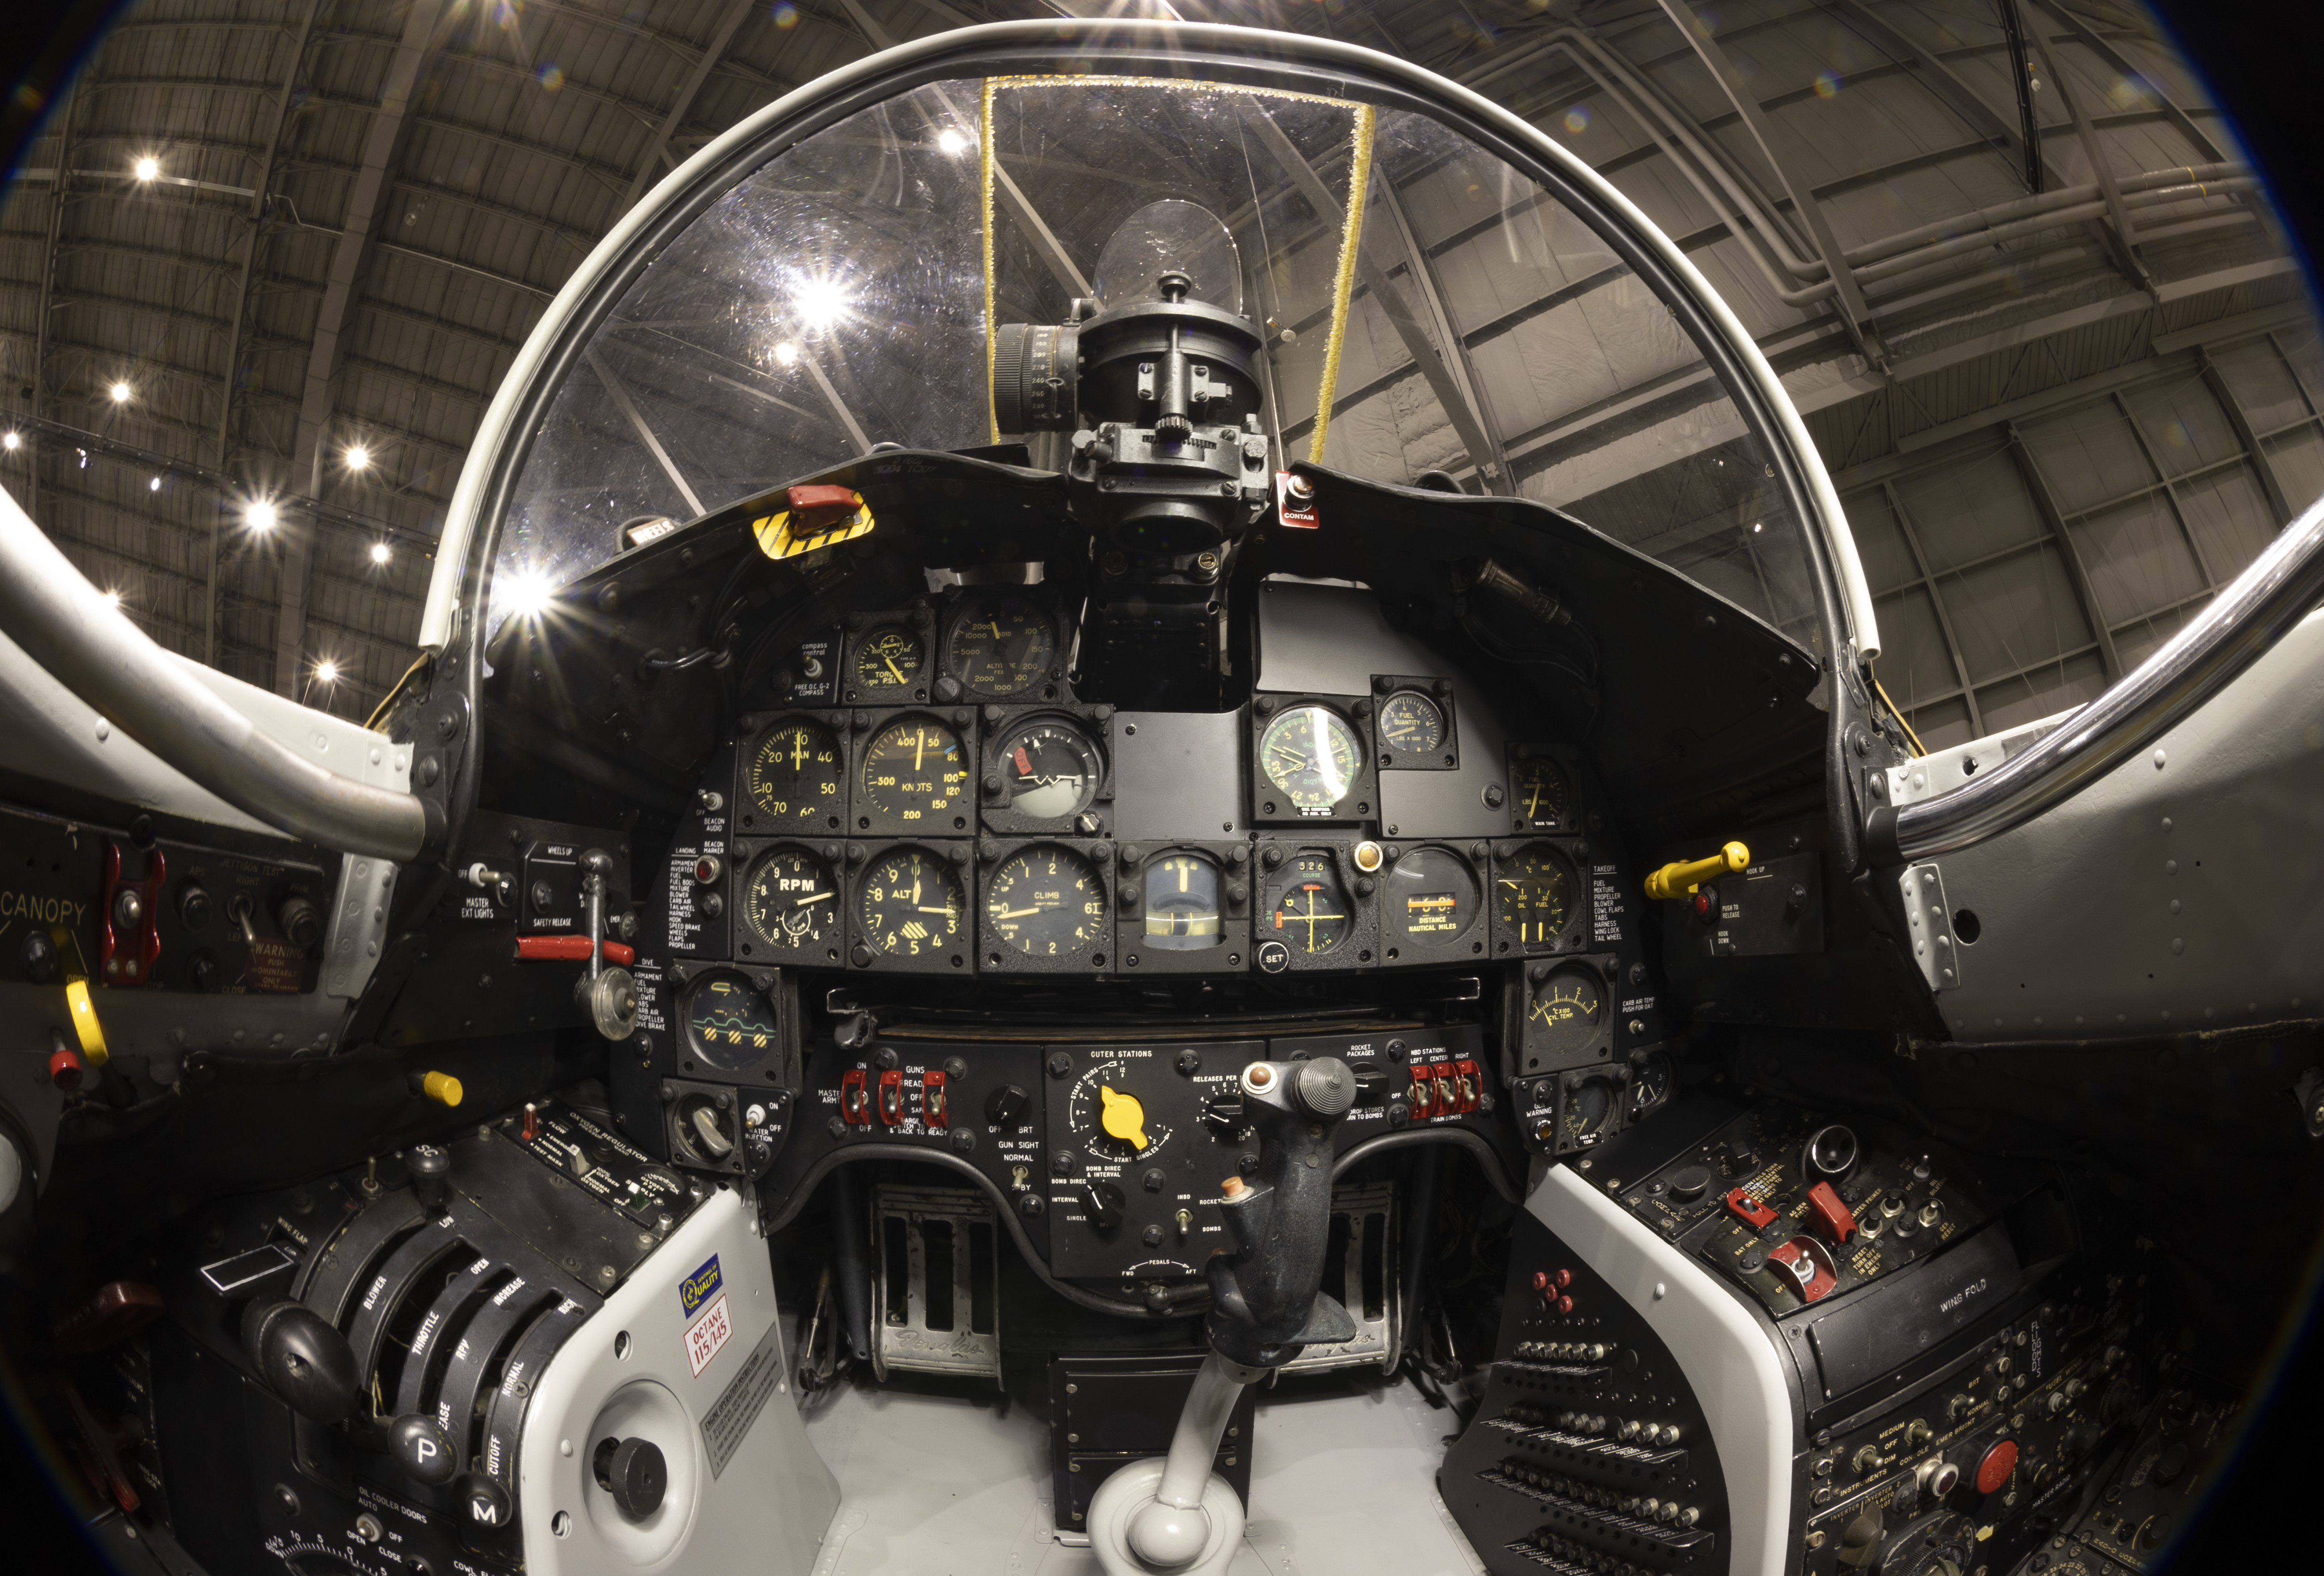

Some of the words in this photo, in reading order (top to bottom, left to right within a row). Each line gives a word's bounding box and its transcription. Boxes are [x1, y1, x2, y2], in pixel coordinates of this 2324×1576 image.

[897, 737, 915, 746] 400
[928, 738, 939, 747] 50
[768, 751, 782, 763] 20
[817, 751, 833, 762] 40
[878, 776, 895, 785] 300
[944, 773, 959, 782] 100
[762, 782, 772, 793] 10
[821, 783, 836, 794] 50
[946, 786, 960, 796] 120
[932, 800, 947, 809] 150
[903, 810, 921, 819] 200
[458, 869, 468, 879] OFF
[236, 875, 260, 887] RIGHT
[780, 878, 815, 892] RPM
[892, 889, 912, 899] ALT
[1594, 892, 1621, 901] PROPELLER
[0, 891, 86, 926] CANOPY
[466, 897, 489, 908] MASTER
[462, 908, 472, 918] EXT
[474, 908, 493, 919] LIGHTS
[533, 918, 552, 927] SAFETY
[552, 917, 572, 927] RELEASE
[255, 943, 303, 959] WARNING
[669, 941, 695, 950] PROPELLER
[268, 958, 284, 967] PUSH
[642, 958, 654, 966] DIVE
[1266, 954, 1284, 963] SET
[251, 966, 297, 978] MOMENTARILY
[263, 976, 280, 985] ONLY
[906, 1065, 925, 1074] GUNS
[769, 1102, 778, 1110] ON
[1526, 1106, 1552, 1118] WARNING
[548, 1121, 568, 1134] FLOW
[770, 1124, 781, 1132] OFF
[569, 1112, 601, 1134] OXYGEN
[601, 1132, 648, 1163] REGULATOR
[745, 1133, 773, 1143] INJECTION
[541, 1140, 563, 1157] NORMAL
[1136, 1145, 1159, 1161] SINGLES
[596, 1171, 620, 1188] OXYGEN
[1865, 1187, 1883, 1204] PRIMER
[1651, 1199, 1685, 1223] COMPASS
[277, 1216, 292, 1232] WING
[292, 1228, 308, 1246] FLAP
[1732, 1226, 1743, 1235] OFF
[1941, 1222, 1956, 1241] RESET
[284, 1246, 297, 1256] UP
[1851, 1247, 1869, 1263] RESET
[471, 1257, 490, 1275] OPEN
[363, 1276, 387, 1311] BLOWER
[493, 1277, 526, 1306] INCREASE
[1775, 1283, 1786, 1293] OFF
[1940, 1293, 1963, 1312] WING
[1964, 1278, 1986, 1298] FOLD
[558, 1298, 578, 1315] RICH
[693, 1306, 722, 1345] OCTANE
[412, 1311, 440, 1356] THROTTLE
[695, 1320, 727, 1365] 115/145
[501, 1361, 524, 1398] NORMAL
[1967, 1399, 1990, 1417] NORMAL
[1879, 1421, 1905, 1439] MEDIUM
[1884, 1438, 1898, 1450] OFF
[418, 1437, 437, 1464] P
[489, 1434, 501, 1475] CUTOFF
[1899, 1445, 1930, 1466] CONSOLE
[1883, 1453, 1897, 1465] DIM
[1839, 1468, 1888, 1497] INSTRUMENTS
[358, 1496, 378, 1511] AUTO
[472, 1500, 497, 1524] M
[2110, 1518, 2124, 1535] VOICE
[346, 1530, 366, 1546] OPEN
[388, 1531, 403, 1543] OFF
[2093, 1538, 2117, 1554] RADIO
[379, 1546, 402, 1564] CLOSE
